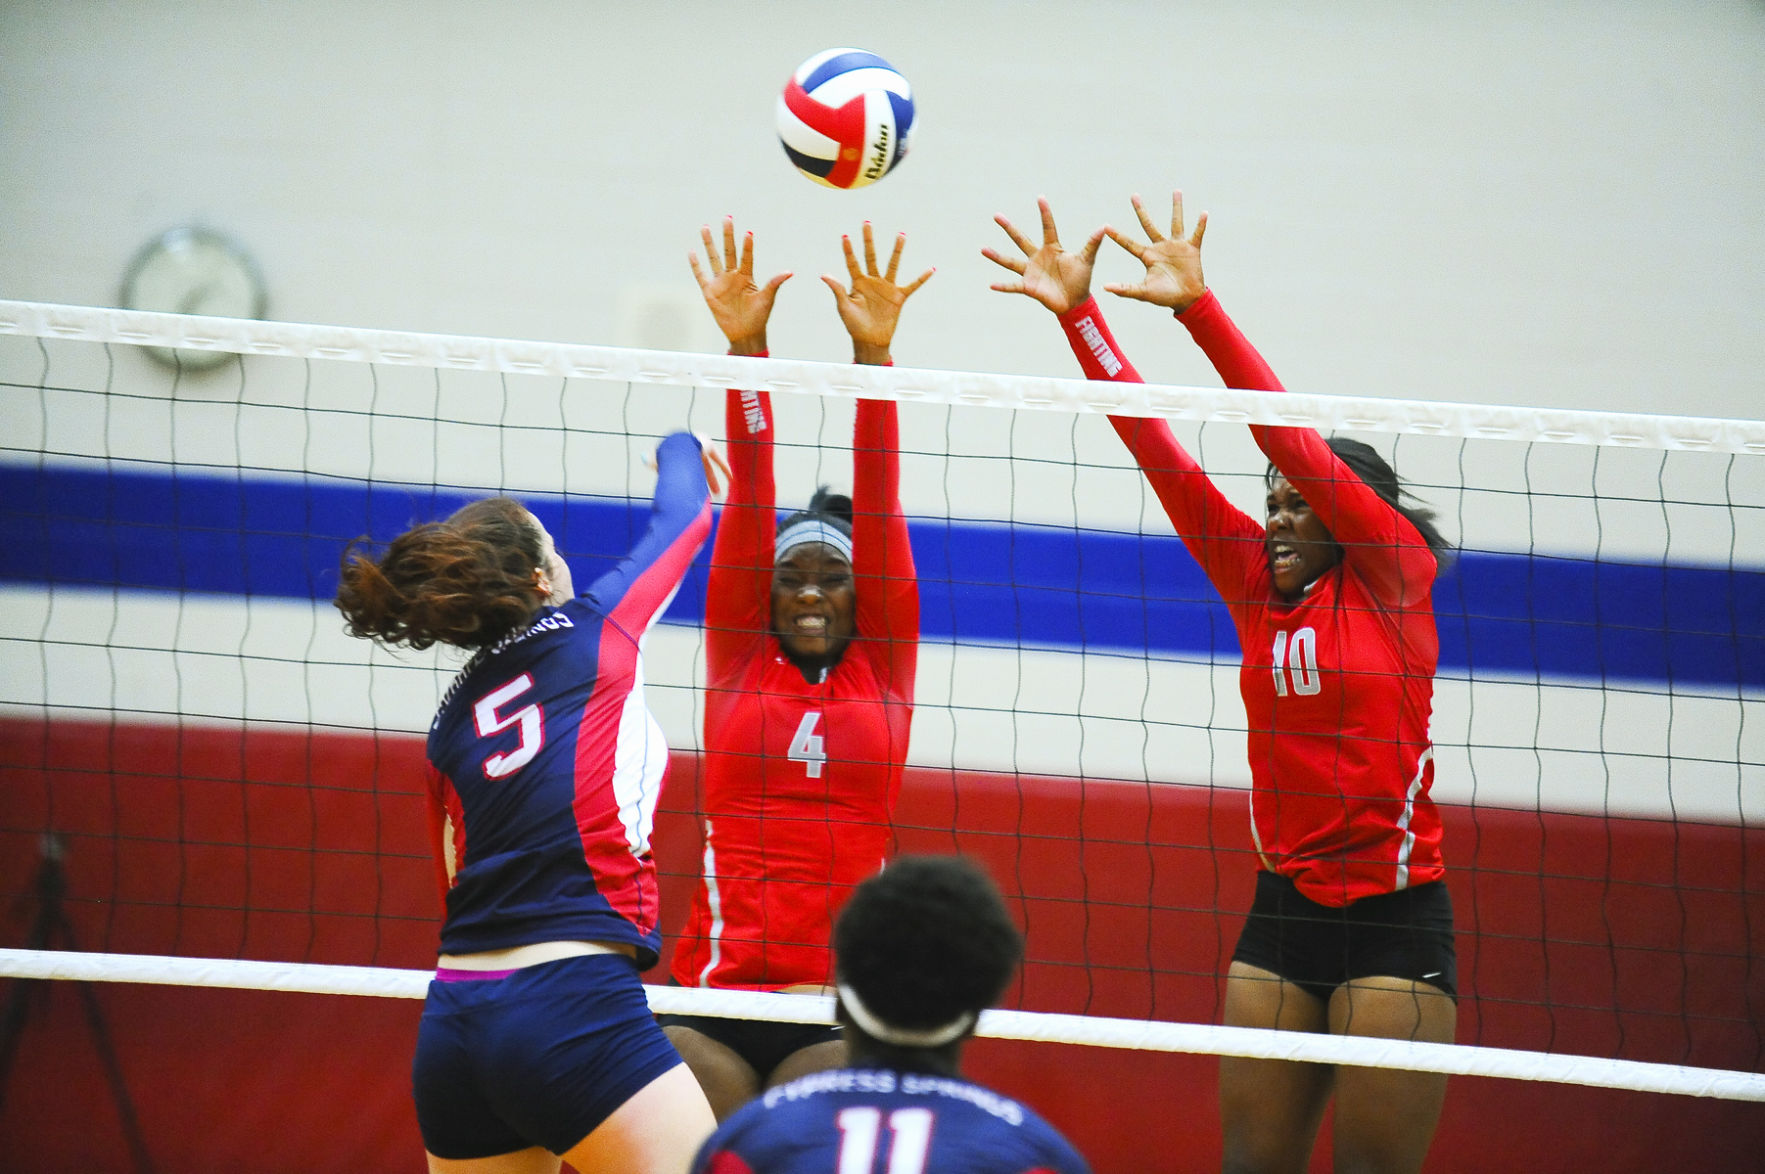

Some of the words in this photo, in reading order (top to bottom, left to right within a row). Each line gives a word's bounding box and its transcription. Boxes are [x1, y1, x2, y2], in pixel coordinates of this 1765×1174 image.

[1272, 626, 1321, 697] 10
[472, 670, 546, 781] 5
[787, 711, 827, 778] 4
[836, 1105, 936, 1174] 11
